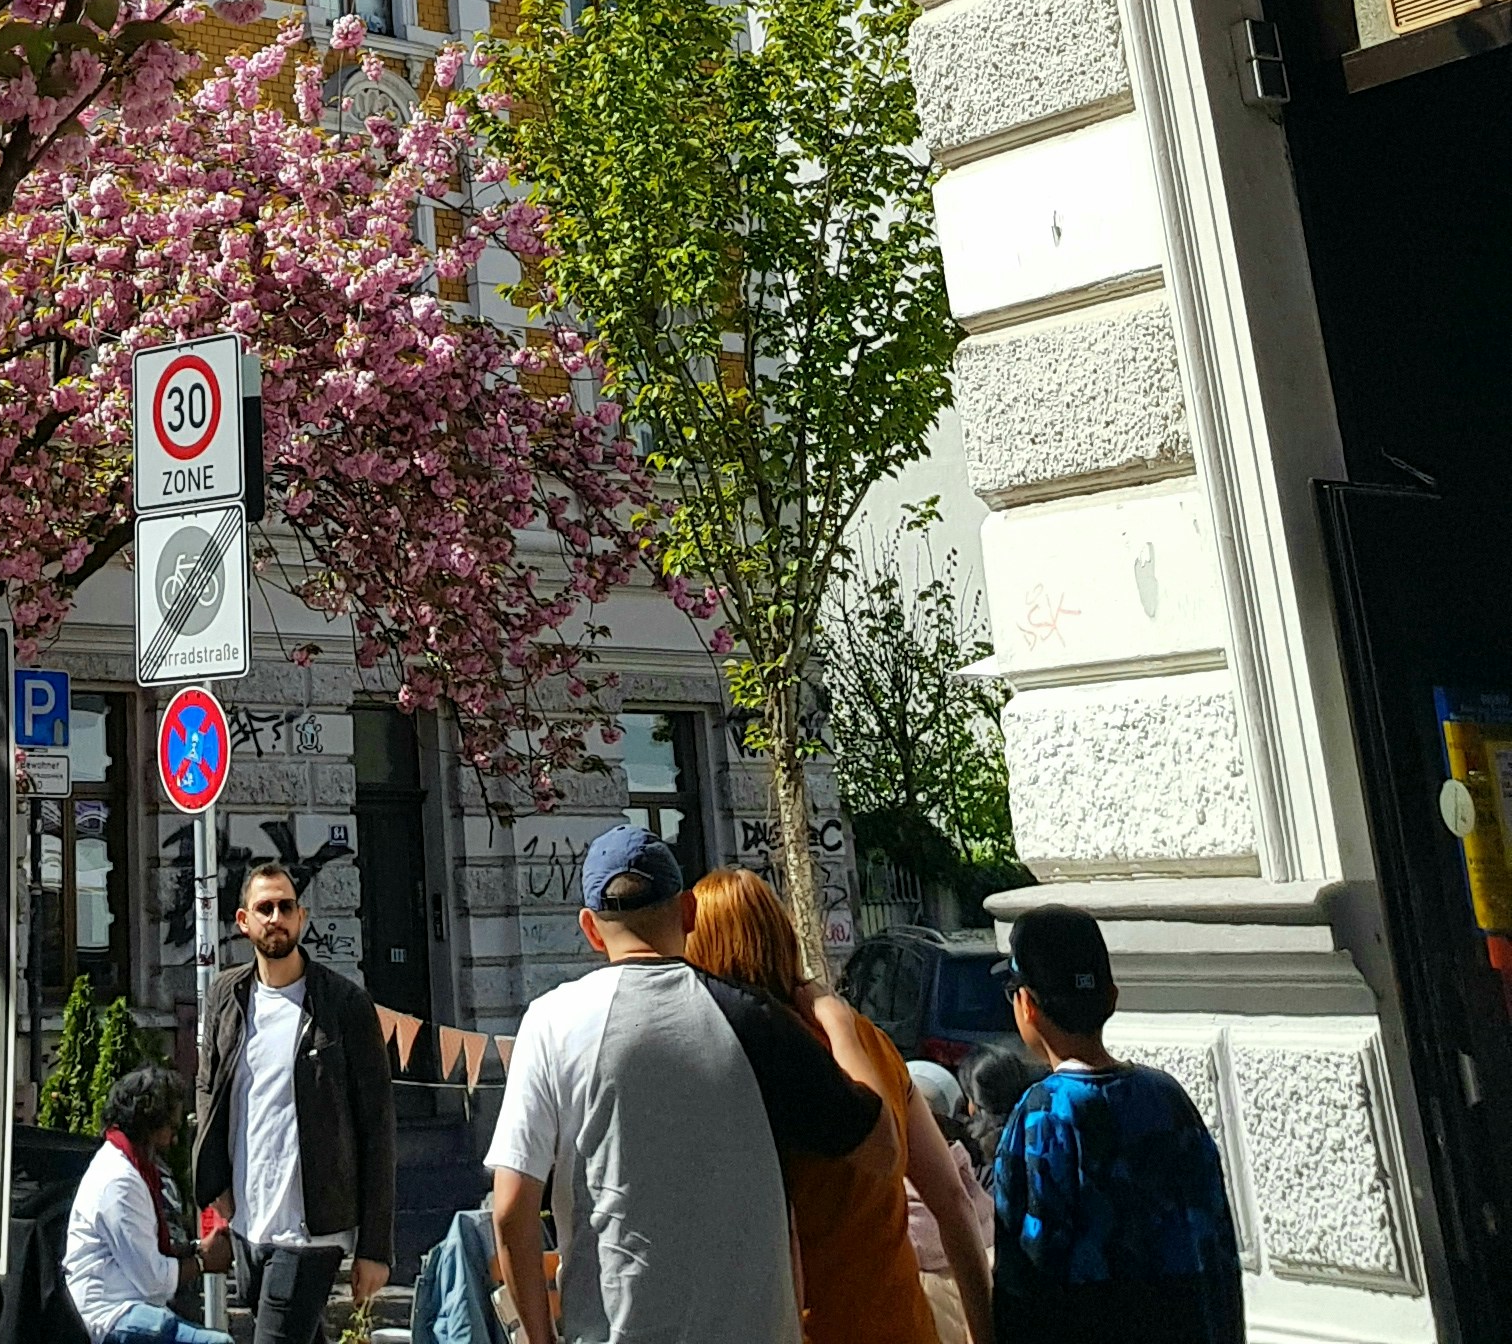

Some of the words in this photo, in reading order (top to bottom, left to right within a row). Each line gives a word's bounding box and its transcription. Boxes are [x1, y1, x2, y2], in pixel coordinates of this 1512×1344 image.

[167, 382, 206, 432] 30
[162, 465, 214, 496] ZONE
[24, 679, 56, 737] P
[333, 825, 345, 840] 84
